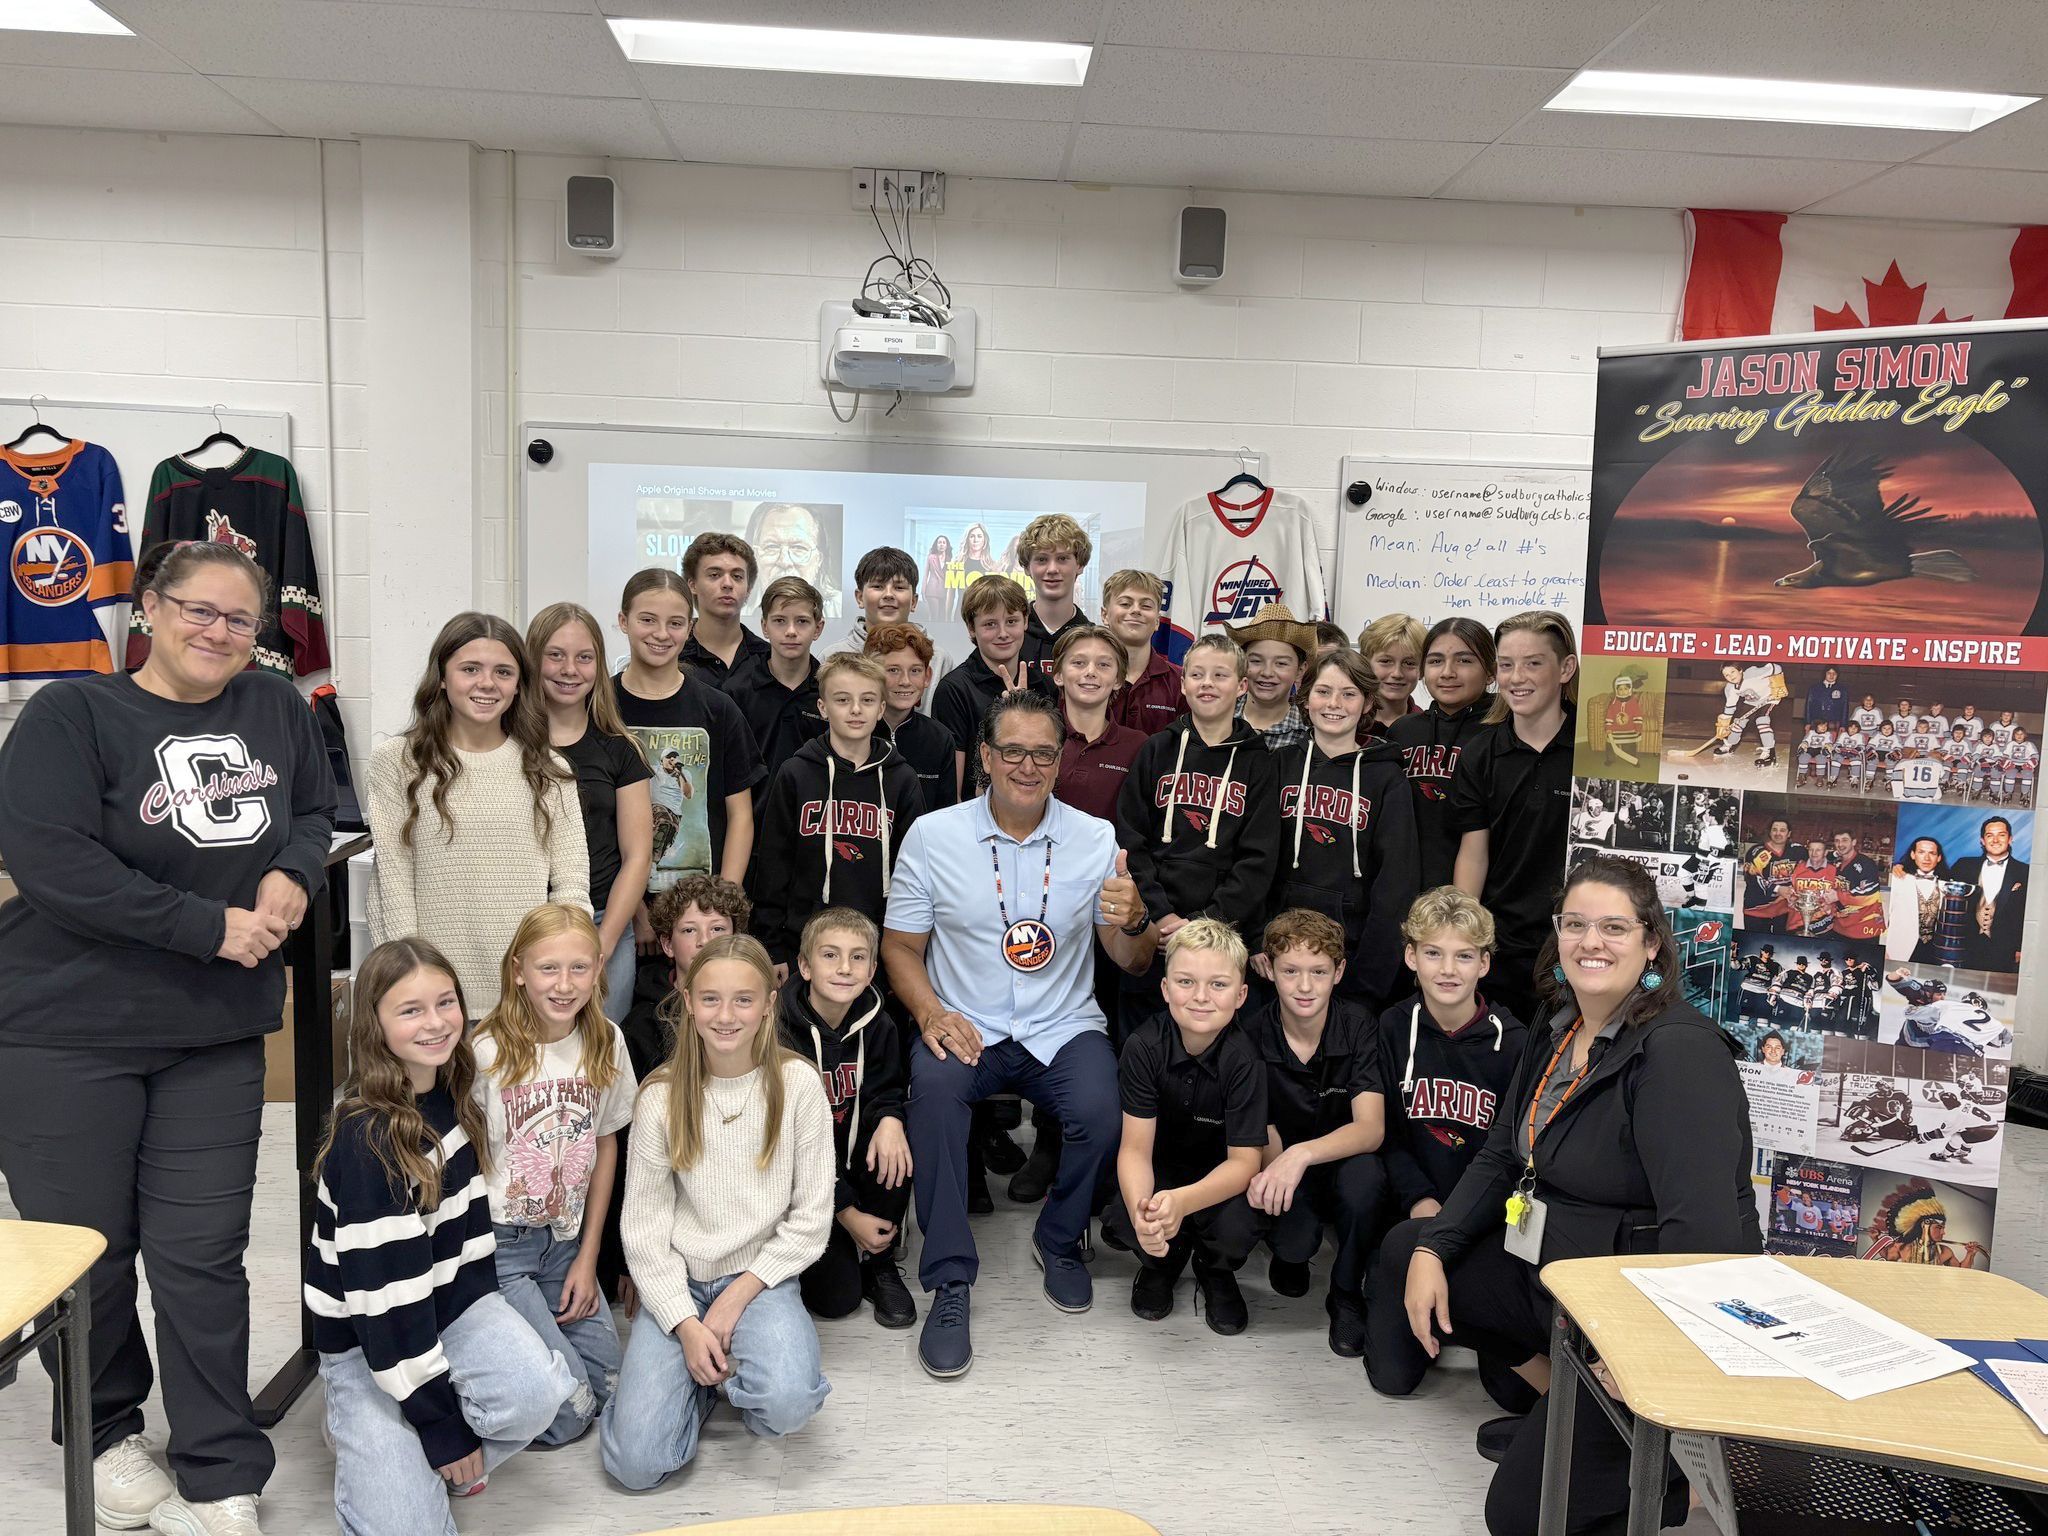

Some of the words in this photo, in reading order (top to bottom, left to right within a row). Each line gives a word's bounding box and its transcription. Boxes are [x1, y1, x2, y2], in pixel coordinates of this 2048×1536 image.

[1686, 351, 1820, 399] JASON
[1835, 341, 1972, 391] SIMON
[1774, 390, 1901, 436] Golden
[636, 485, 661, 495] Apple
[664, 486, 695, 496] Original
[698, 487, 726, 496] Shows
[729, 488, 745, 497] and
[747, 488, 777, 498] Movies
[112, 503, 129, 533] 3
[26, 535, 72, 563] NY
[1486, 539, 1507, 552] all
[946, 561, 965, 570] THE
[22, 571, 82, 598] ISLANDERS
[1219, 579, 1272, 591] WINNIPEG
[1434, 572, 1472, 588] Order
[1521, 570, 1537, 586] to
[1442, 594, 1472, 608] then
[1479, 592, 1499, 607] the
[1603, 631, 1697, 654] EDUCATE
[1714, 634, 1772, 656] LEAD
[1788, 636, 1907, 661] MOTIVATE
[1923, 640, 2022, 665] INSPIRE
[649, 733, 703, 750] NIGHT
[681, 752, 706, 767] TIME
[1912, 766, 1932, 782] 16
[140, 759, 278, 825] Cardinals
[154, 733, 272, 848] C
[1155, 772, 1247, 817] CARDS
[1280, 785, 1371, 831] CARDS
[800, 800, 894, 841] CARDS
[1665, 864, 1675, 876] hp
[1797, 878, 1833, 892] BLAST
[1011, 925, 1040, 945] NY
[1010, 946, 1049, 966] ISLANDERS
[1962, 1010, 1991, 1031] 2
[1852, 1074, 1877, 1083] GMC
[501, 1080, 554, 1144] DOLLY
[1799, 1168, 1824, 1181] UBS
[1826, 1175, 1853, 1186] Arena
[1803, 1182, 1819, 1190] YORK
[1820, 1184, 1850, 1194] ISLANDERS
